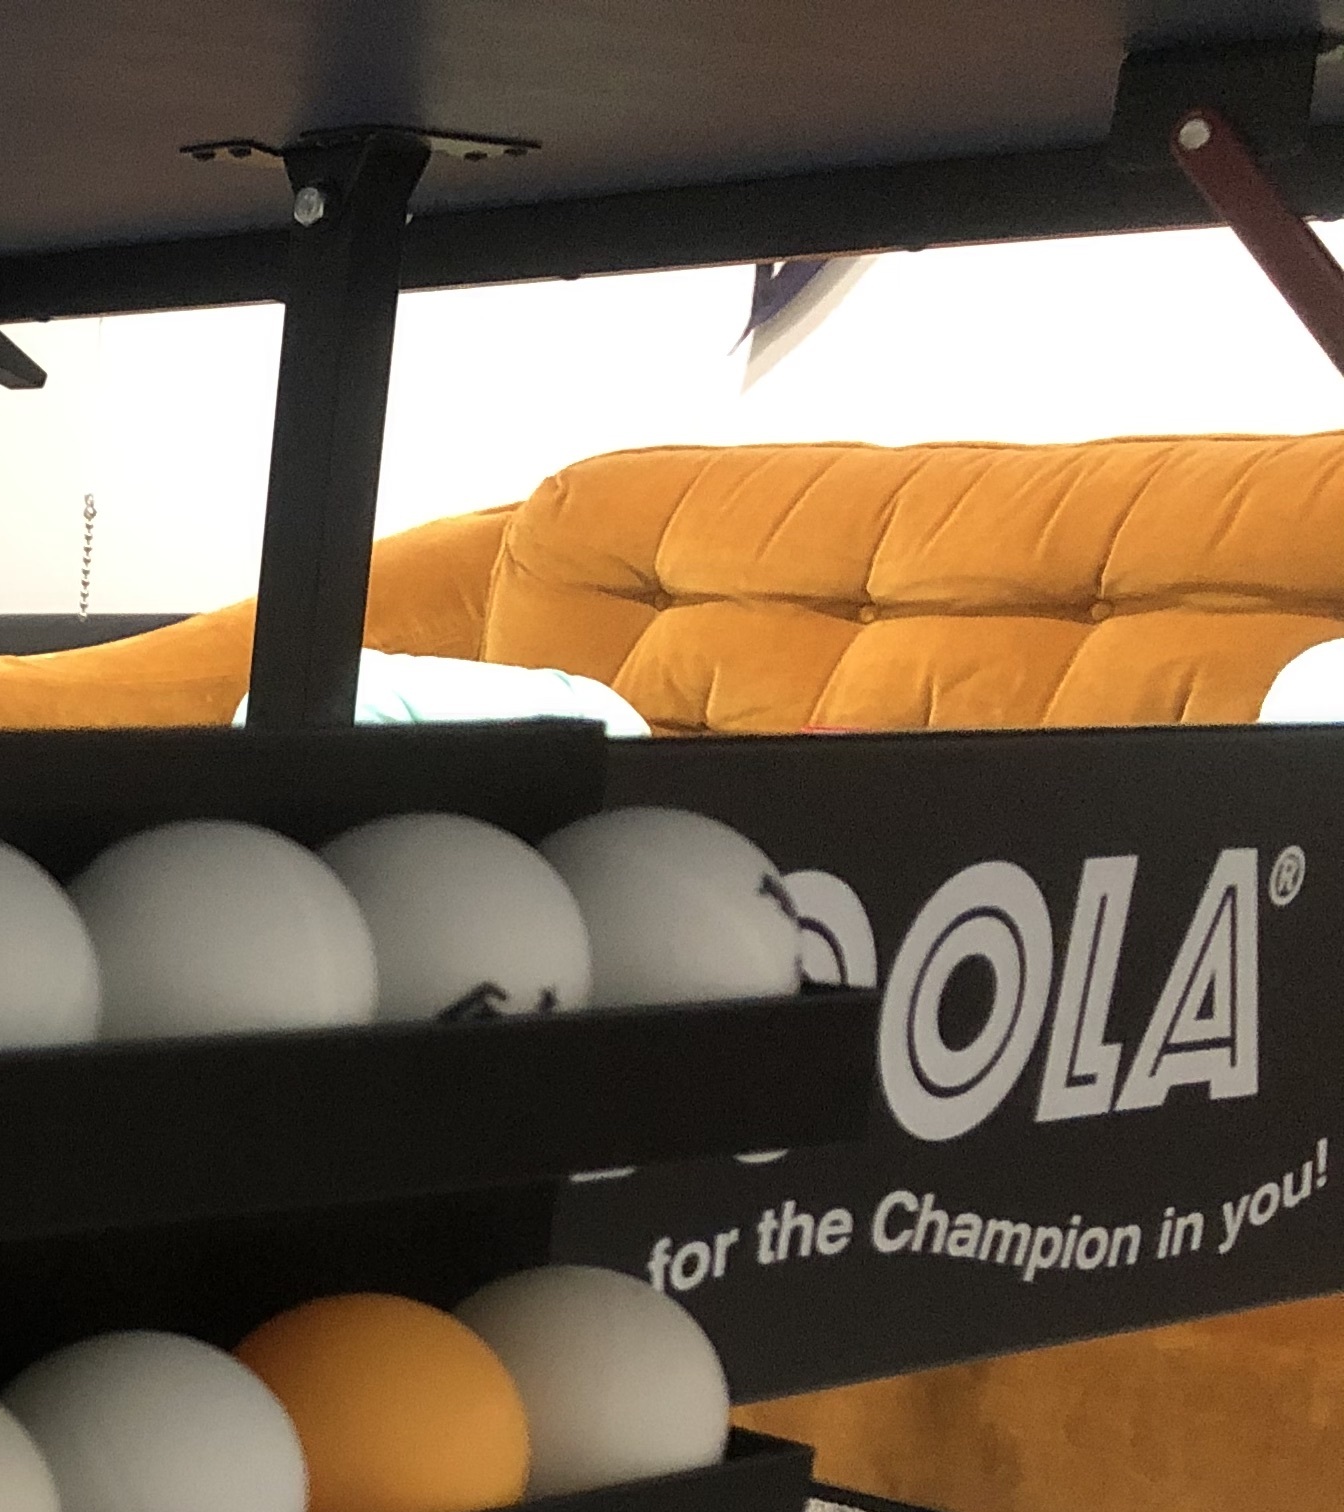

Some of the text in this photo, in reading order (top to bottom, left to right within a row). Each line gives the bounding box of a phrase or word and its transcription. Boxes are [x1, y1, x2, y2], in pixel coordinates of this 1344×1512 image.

[647, 1136, 1329, 1292] for the Champion in you!
